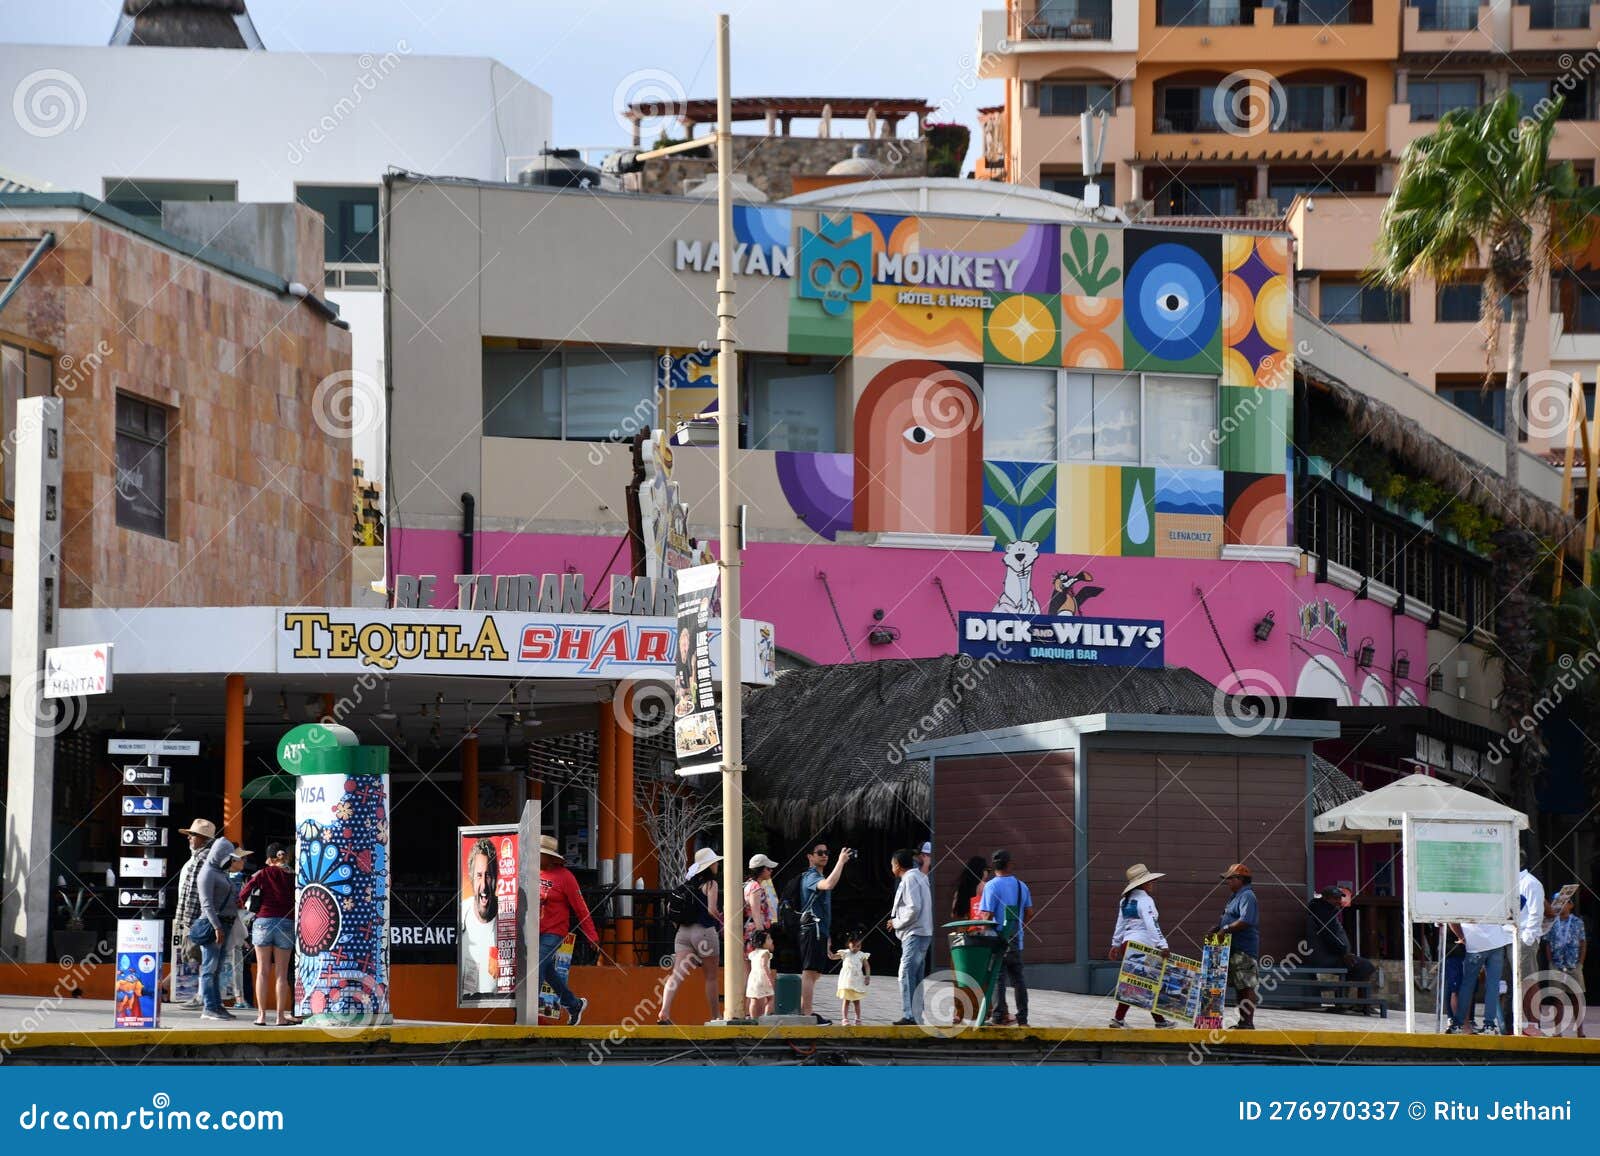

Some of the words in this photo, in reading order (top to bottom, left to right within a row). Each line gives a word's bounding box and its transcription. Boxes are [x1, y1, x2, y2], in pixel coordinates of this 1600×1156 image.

[675, 239, 796, 277] MAYAN
[877, 251, 1020, 290] MONKEY
[898, 293, 935, 306] HOTEL
[937, 295, 947, 306] &
[950, 295, 995, 309] HOSTEL
[610, 574, 677, 616] BAR
[285, 612, 509, 670] TEQUILA
[518, 620, 714, 672] SHAR
[965, 617, 1032, 642] DICK
[1033, 628, 1053, 638] AND
[1052, 622, 1161, 649] WILLY'S
[1030, 646, 1075, 660] DAIQUIRI
[1076, 647, 1098, 660] BAR
[52, 676, 95, 693] MANTA
[299, 786, 326, 804] VISA
[498, 878, 516, 896] 2x1
[390, 926, 458, 945] BREAKF
[500, 966, 513, 976] LIVE
[498, 976, 516, 988] MUSIC
[1127, 977, 1153, 990] FISHING
